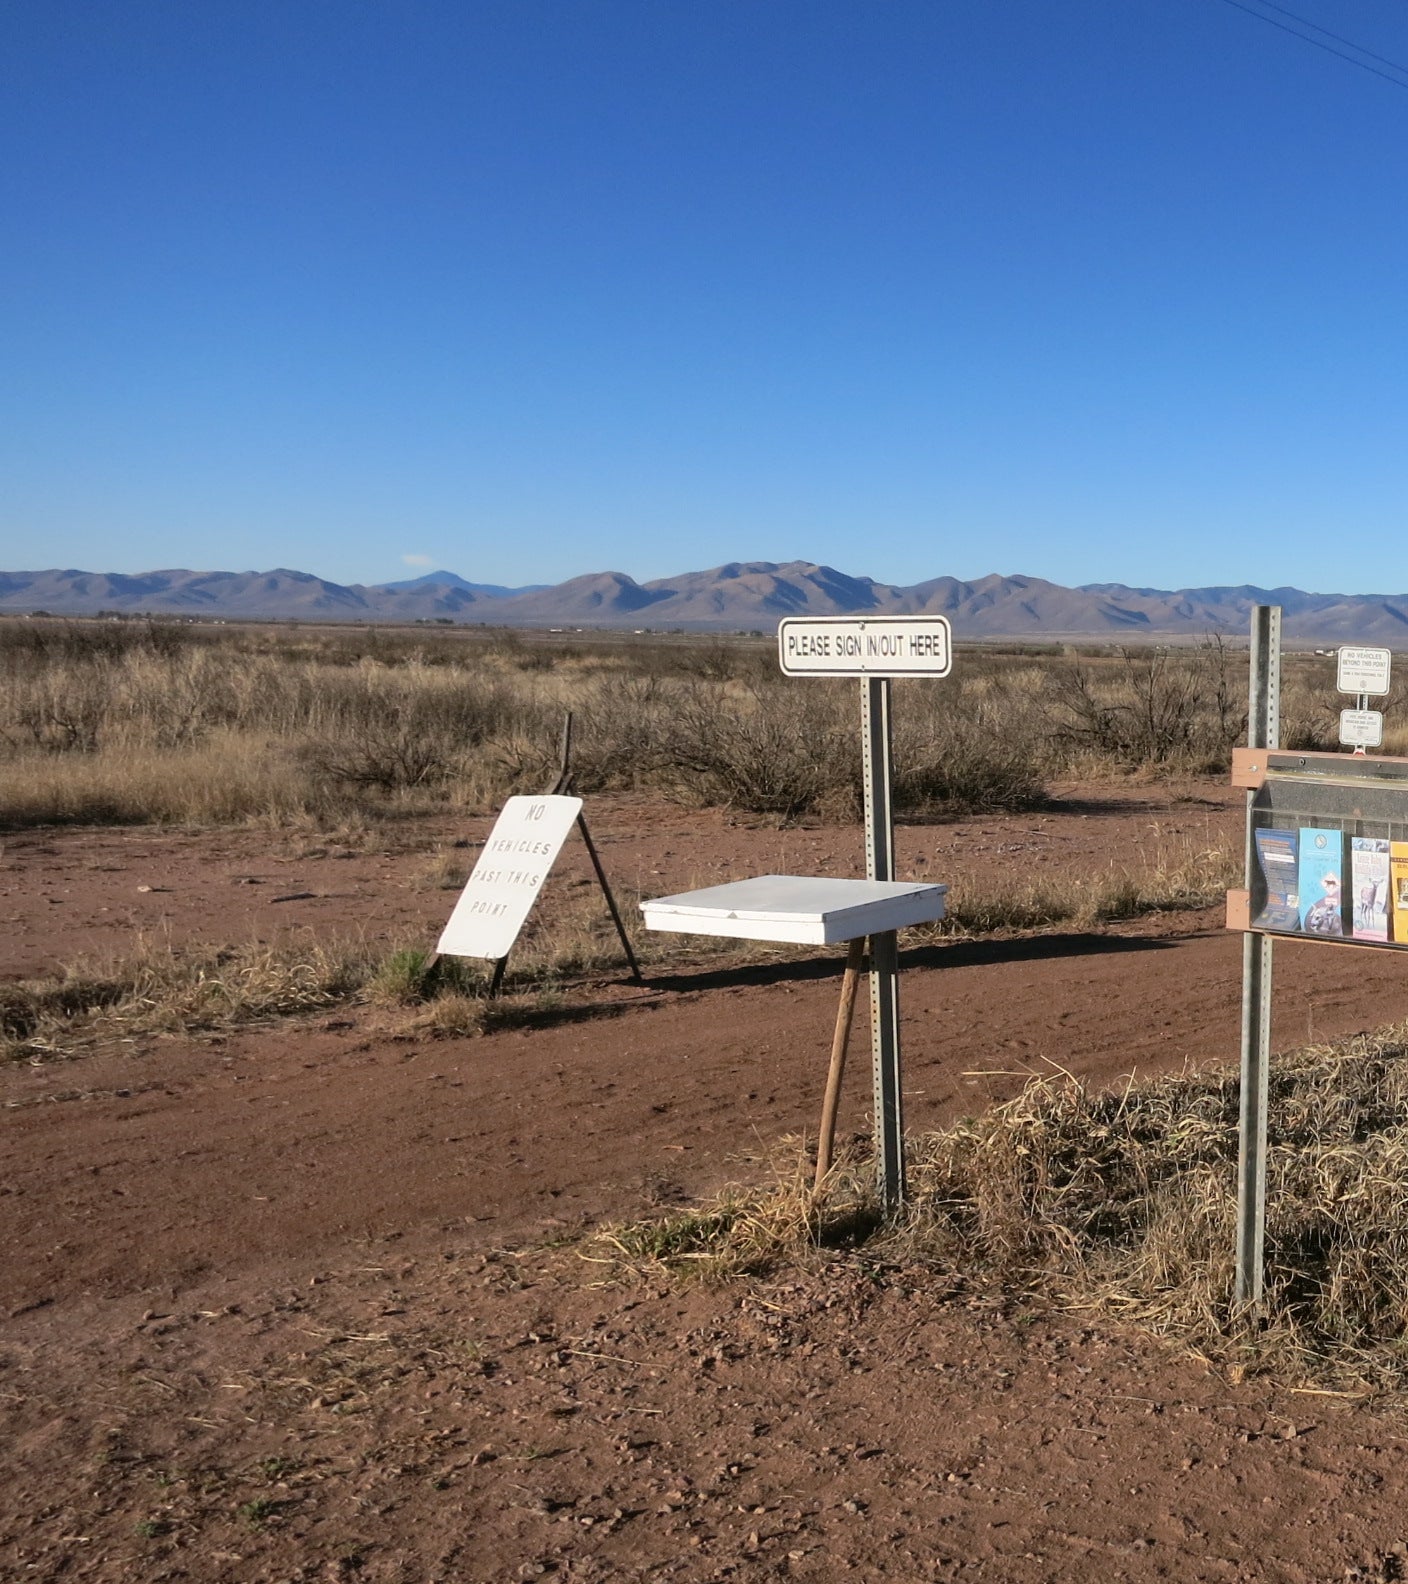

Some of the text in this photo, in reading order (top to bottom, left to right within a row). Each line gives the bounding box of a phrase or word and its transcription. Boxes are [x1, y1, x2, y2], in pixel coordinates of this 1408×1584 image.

[788, 635, 941, 656] PLEASE SIGN IN/OUT HERE
[525, 804, 546, 821] NO
[492, 840, 551, 855] VEHICLES
[474, 869, 540, 888] PAST THIS
[471, 901, 507, 916] POINT
